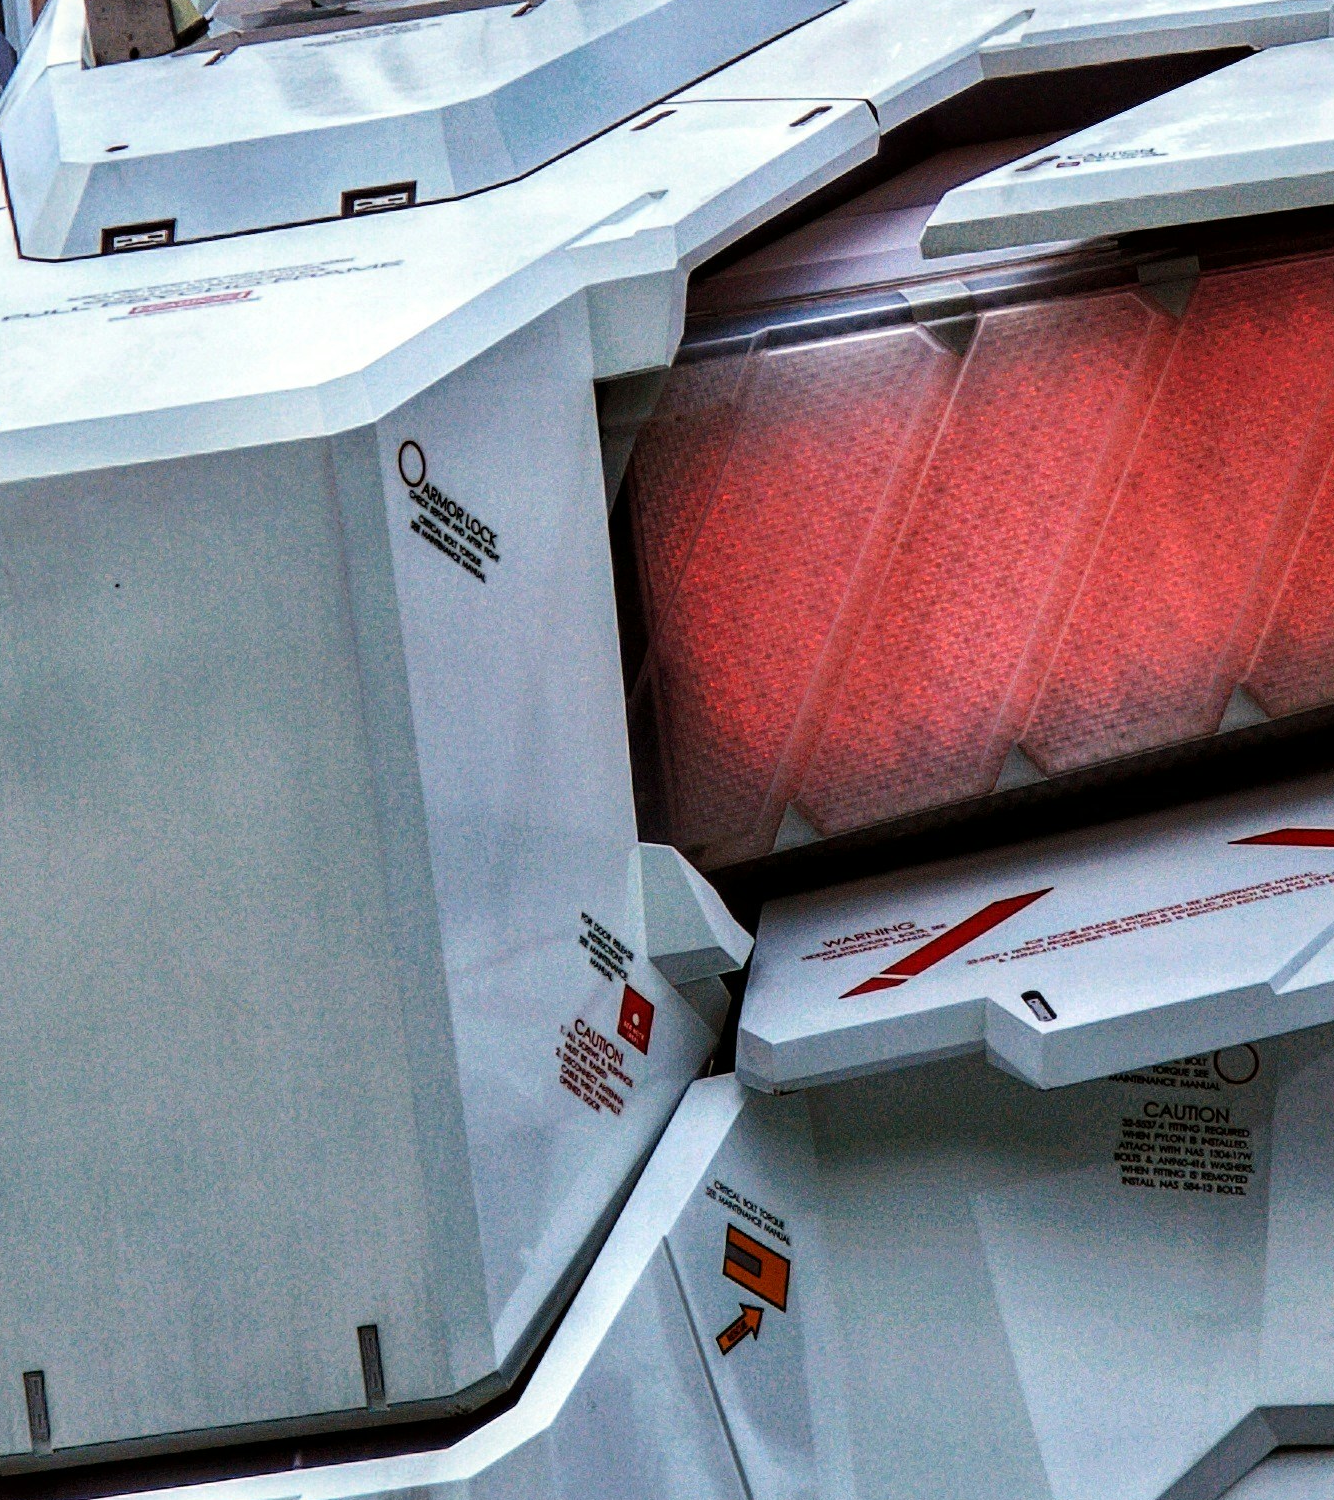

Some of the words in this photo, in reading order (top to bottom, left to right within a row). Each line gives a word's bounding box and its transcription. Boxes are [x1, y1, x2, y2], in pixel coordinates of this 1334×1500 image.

[421, 483, 464, 524] ARMOR
[465, 514, 498, 549] LOCK
[823, 921, 915, 948] WARNING
[574, 1019, 624, 1066] CAUTION
[1180, 1081, 1220, 1091] MANUAL
[1143, 1102, 1230, 1124] CAUTION
[1122, 1130, 1151, 1140] WHEN
[1155, 1133, 1187, 1144] PYLON
[1168, 1122, 1200, 1133] FITTING
[1205, 1126, 1250, 1137] REQUIRED
[1119, 1142, 1155, 1152] ATTACH
[1159, 1145, 1181, 1155] WITH
[1185, 1147, 1204, 1157] NAS
[1115, 1152, 1141, 1163] BOLTS
[1146, 1155, 1153, 1164] &
[1121, 1165, 1149, 1175] WHEN
[1154, 1168, 1185, 1179] FITTING
[1189, 1171, 1197, 1179] IS
[1201, 1172, 1248, 1184] REMOVED
[1122, 1177, 1155, 1187] INSTALL
[1160, 1180, 1179, 1189] NAS
